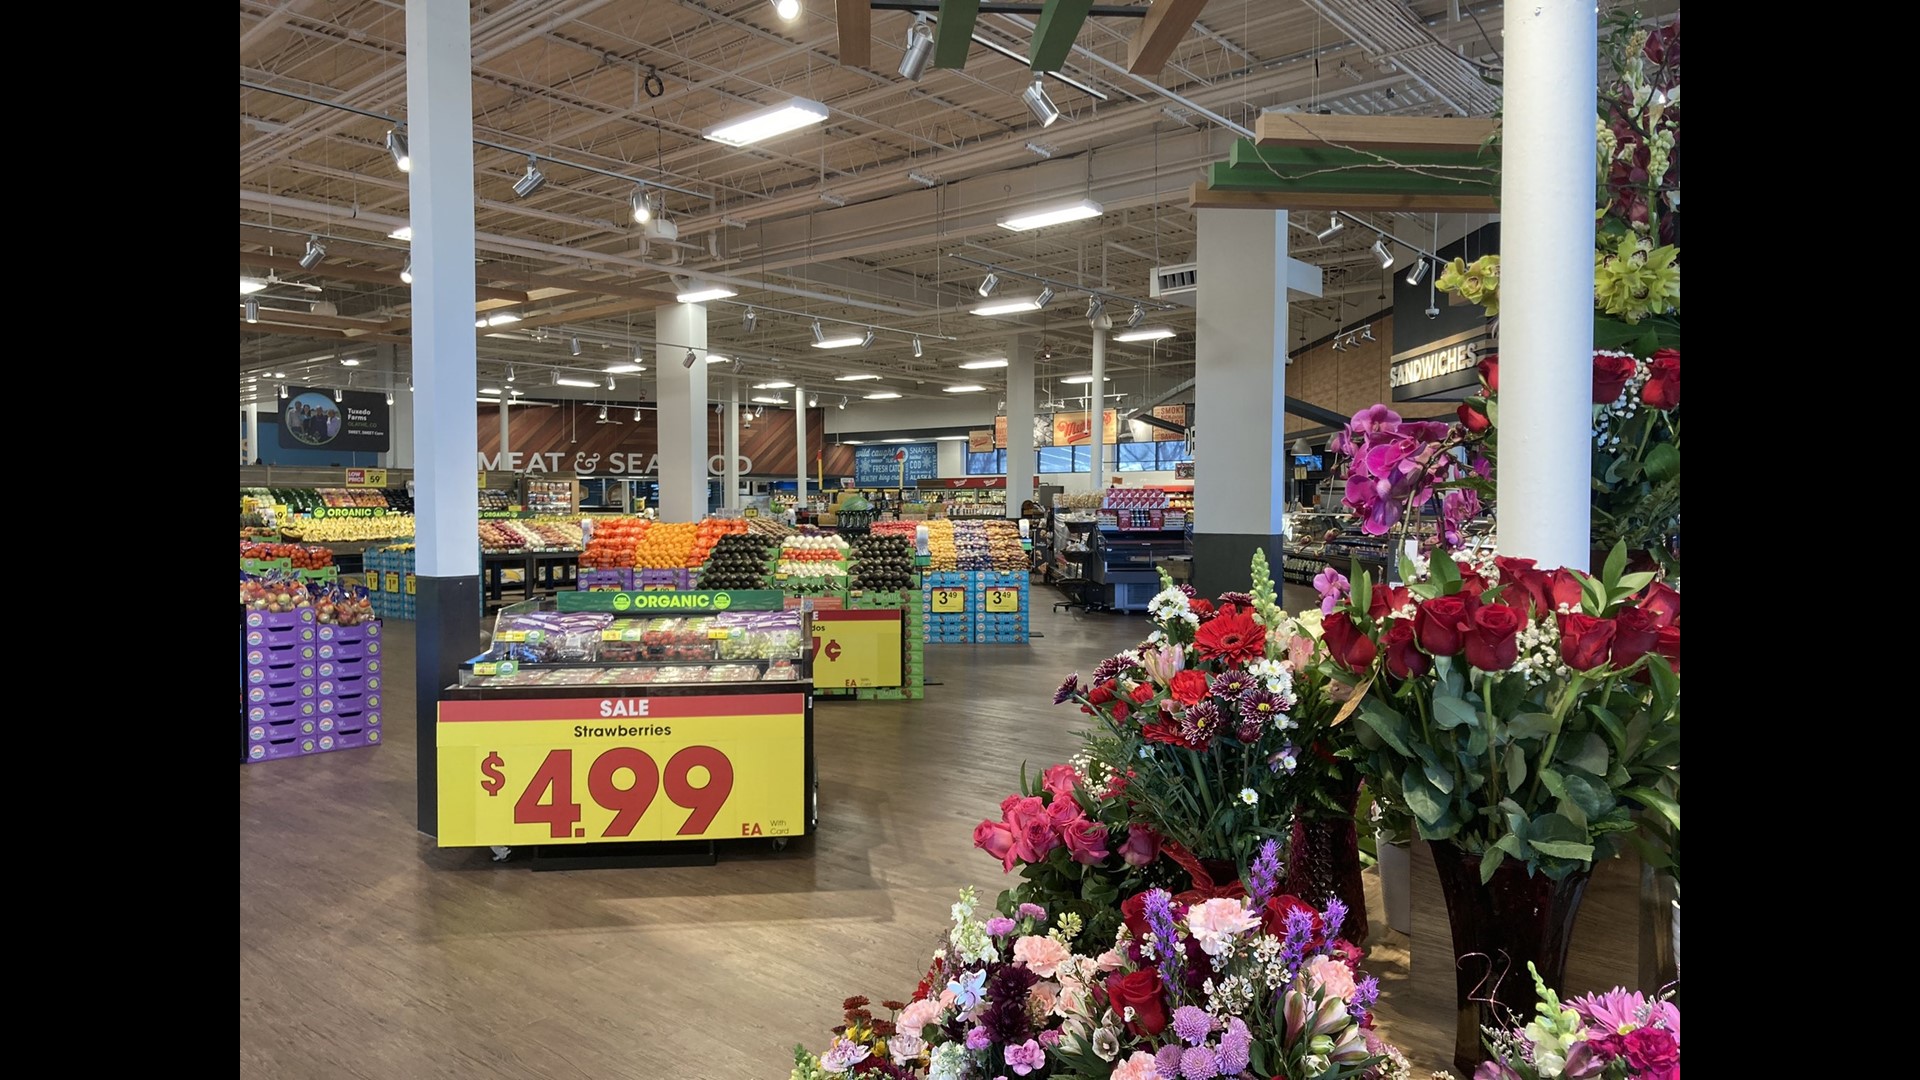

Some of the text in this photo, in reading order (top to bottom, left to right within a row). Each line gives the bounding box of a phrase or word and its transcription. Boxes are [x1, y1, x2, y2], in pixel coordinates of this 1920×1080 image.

[1390, 343, 1477, 388] SANDWICHES
[1160, 406, 1185, 415] SMOKY
[871, 447, 896, 459] caught
[909, 446, 937, 455] SNAPPER
[478, 451, 753, 475] MEAT & SEAOD
[909, 460, 922, 469] COD
[872, 464, 888, 473] FRESH
[888, 464, 901, 472] CATC
[327, 508, 372, 517] ORGANIC
[635, 595, 709, 608] ORGANIC
[845, 679, 857, 687] EA
[600, 699, 649, 717] SALE
[574, 723, 672, 738] Strawberries
[769, 819, 787, 827] With
[742, 822, 763, 836] EA
[769, 827, 790, 836] Card
